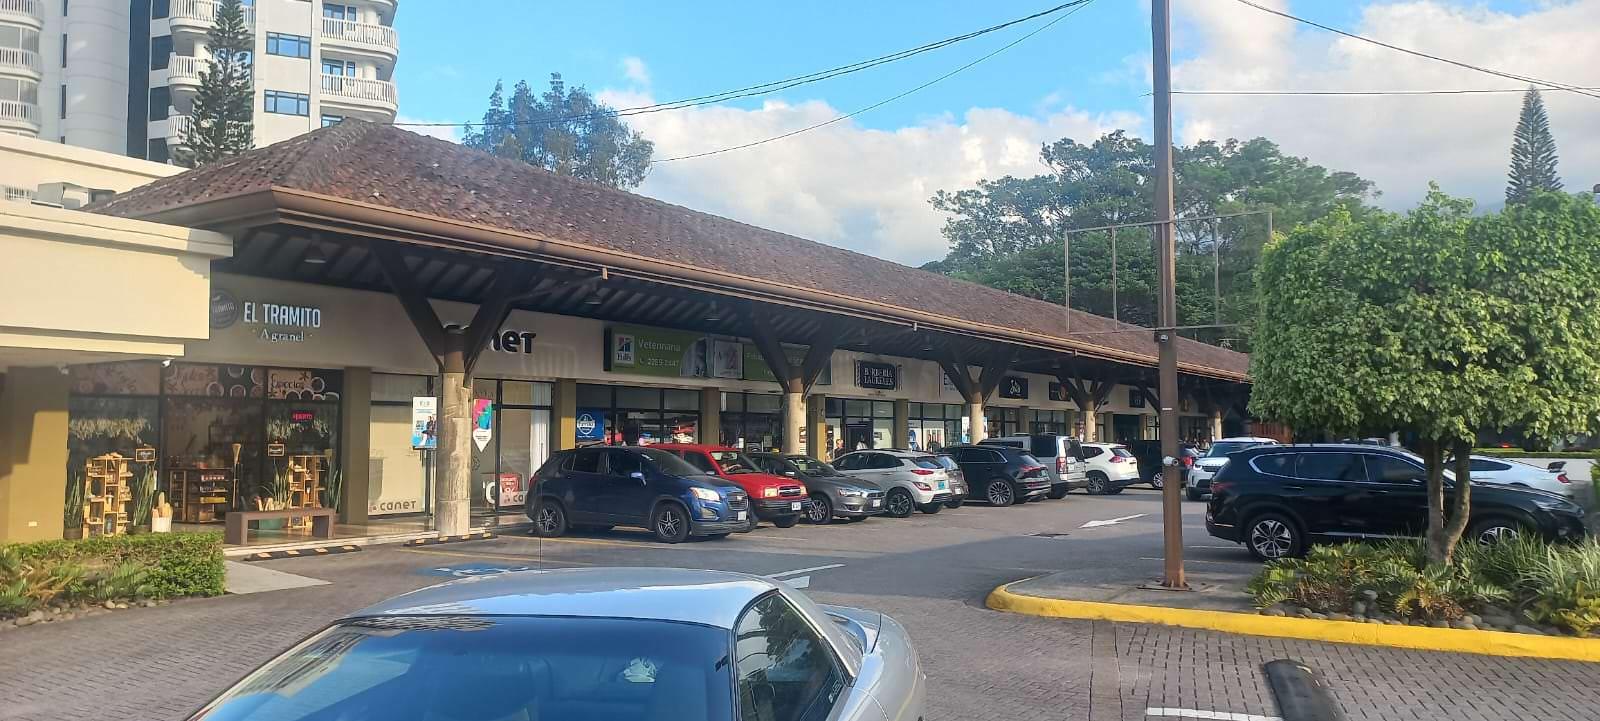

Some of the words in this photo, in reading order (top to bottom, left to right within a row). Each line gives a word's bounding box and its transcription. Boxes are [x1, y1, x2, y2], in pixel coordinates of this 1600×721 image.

[244, 302, 258, 323] EL
[263, 304, 321, 328] TRAMITO
[261, 329, 269, 340] A
[271, 330, 305, 343] granel
